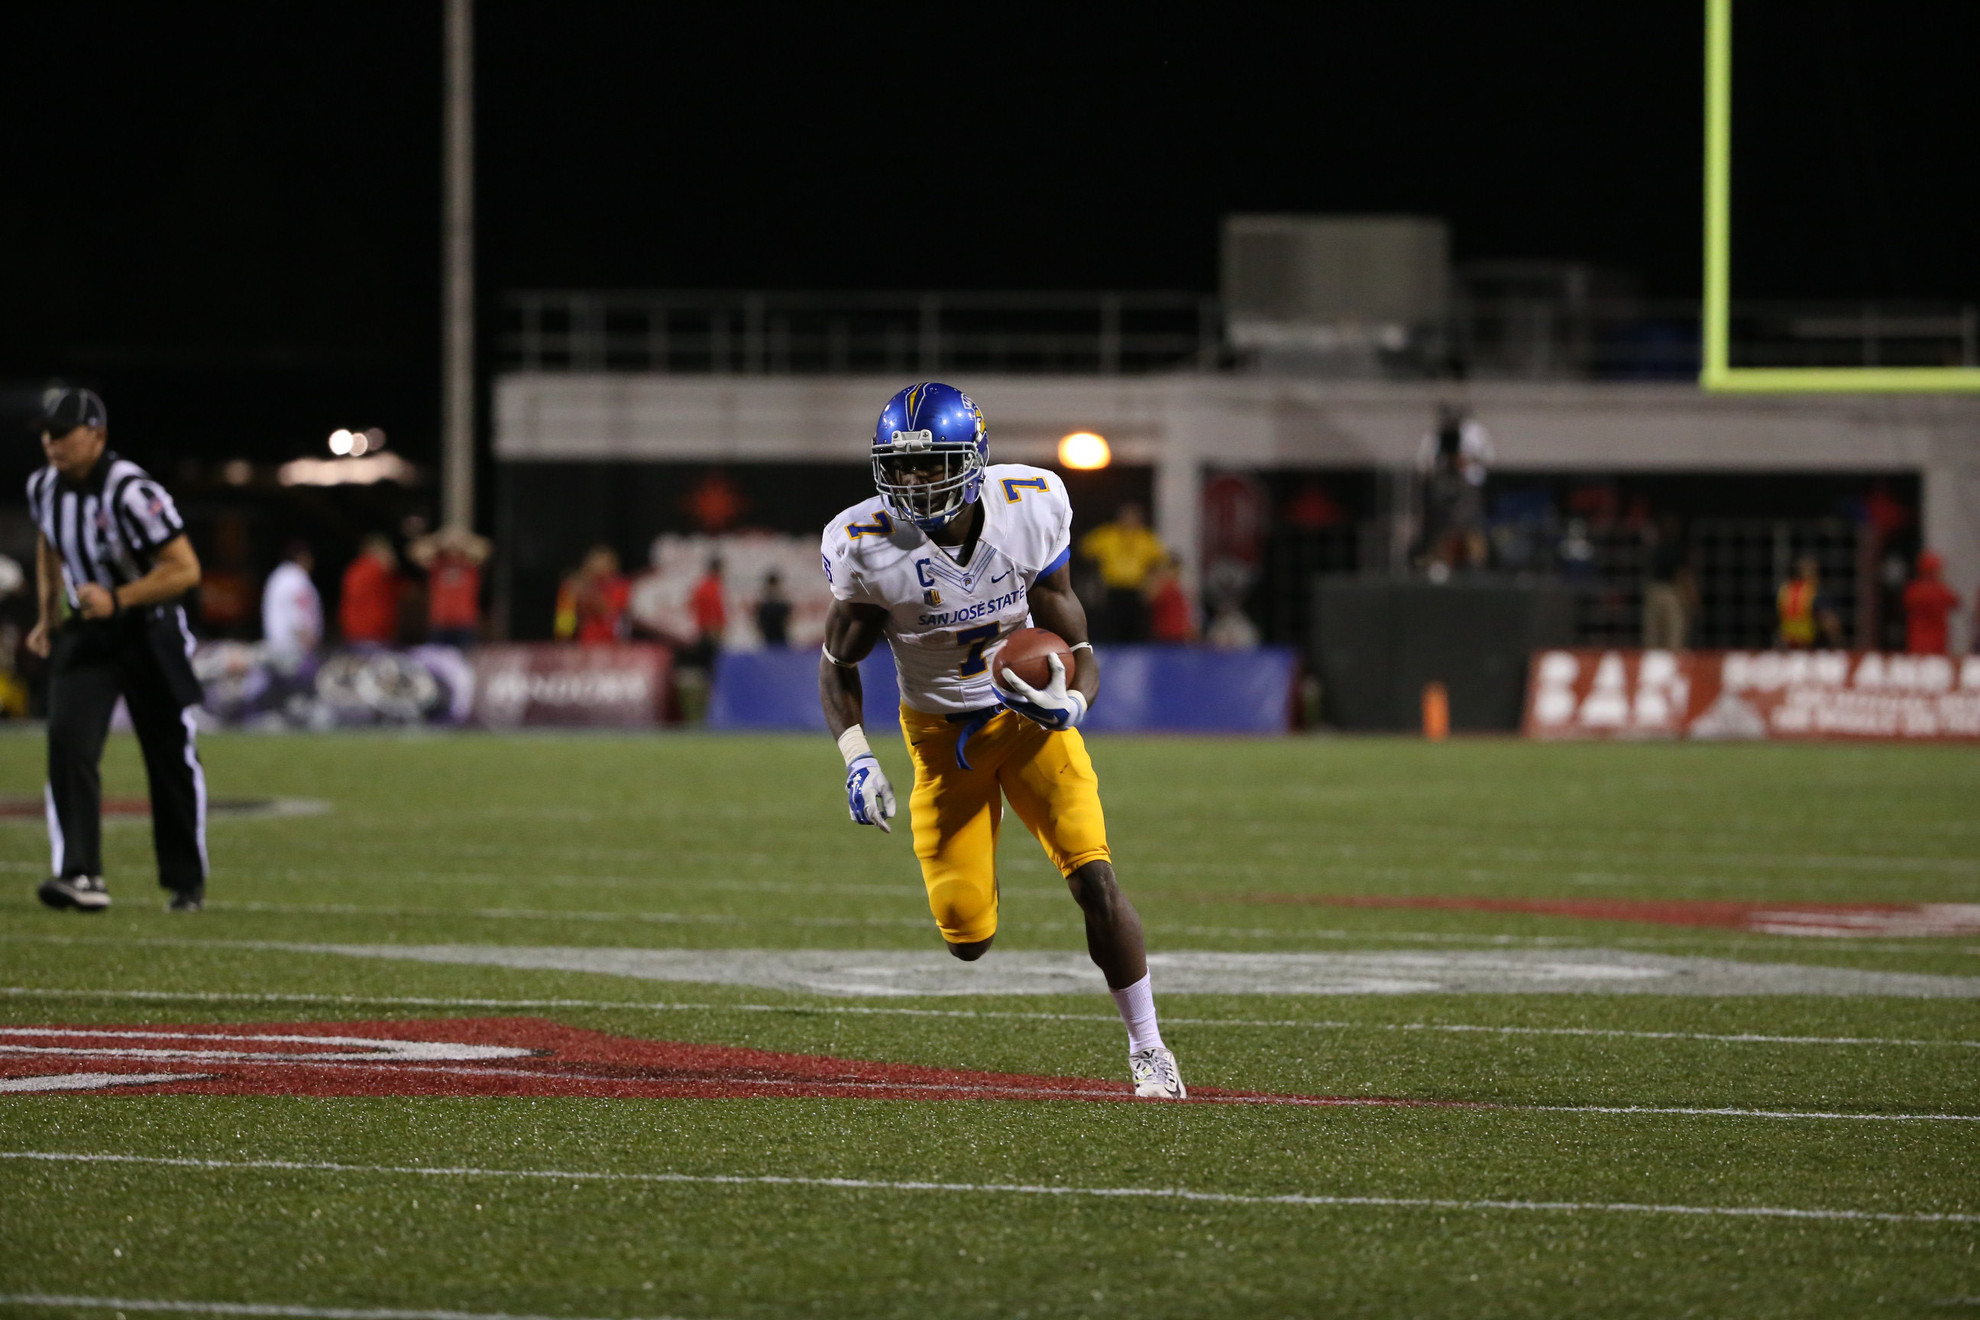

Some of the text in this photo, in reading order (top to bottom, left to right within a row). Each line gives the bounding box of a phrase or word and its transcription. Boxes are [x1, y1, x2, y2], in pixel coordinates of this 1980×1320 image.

[1000, 476, 1050, 504] 7
[845, 510, 895, 540] 7
[915, 558, 935, 587] C
[918, 612, 949, 626] SAN
[987, 585, 1025, 613] STATE
[954, 620, 1002, 679] 7
